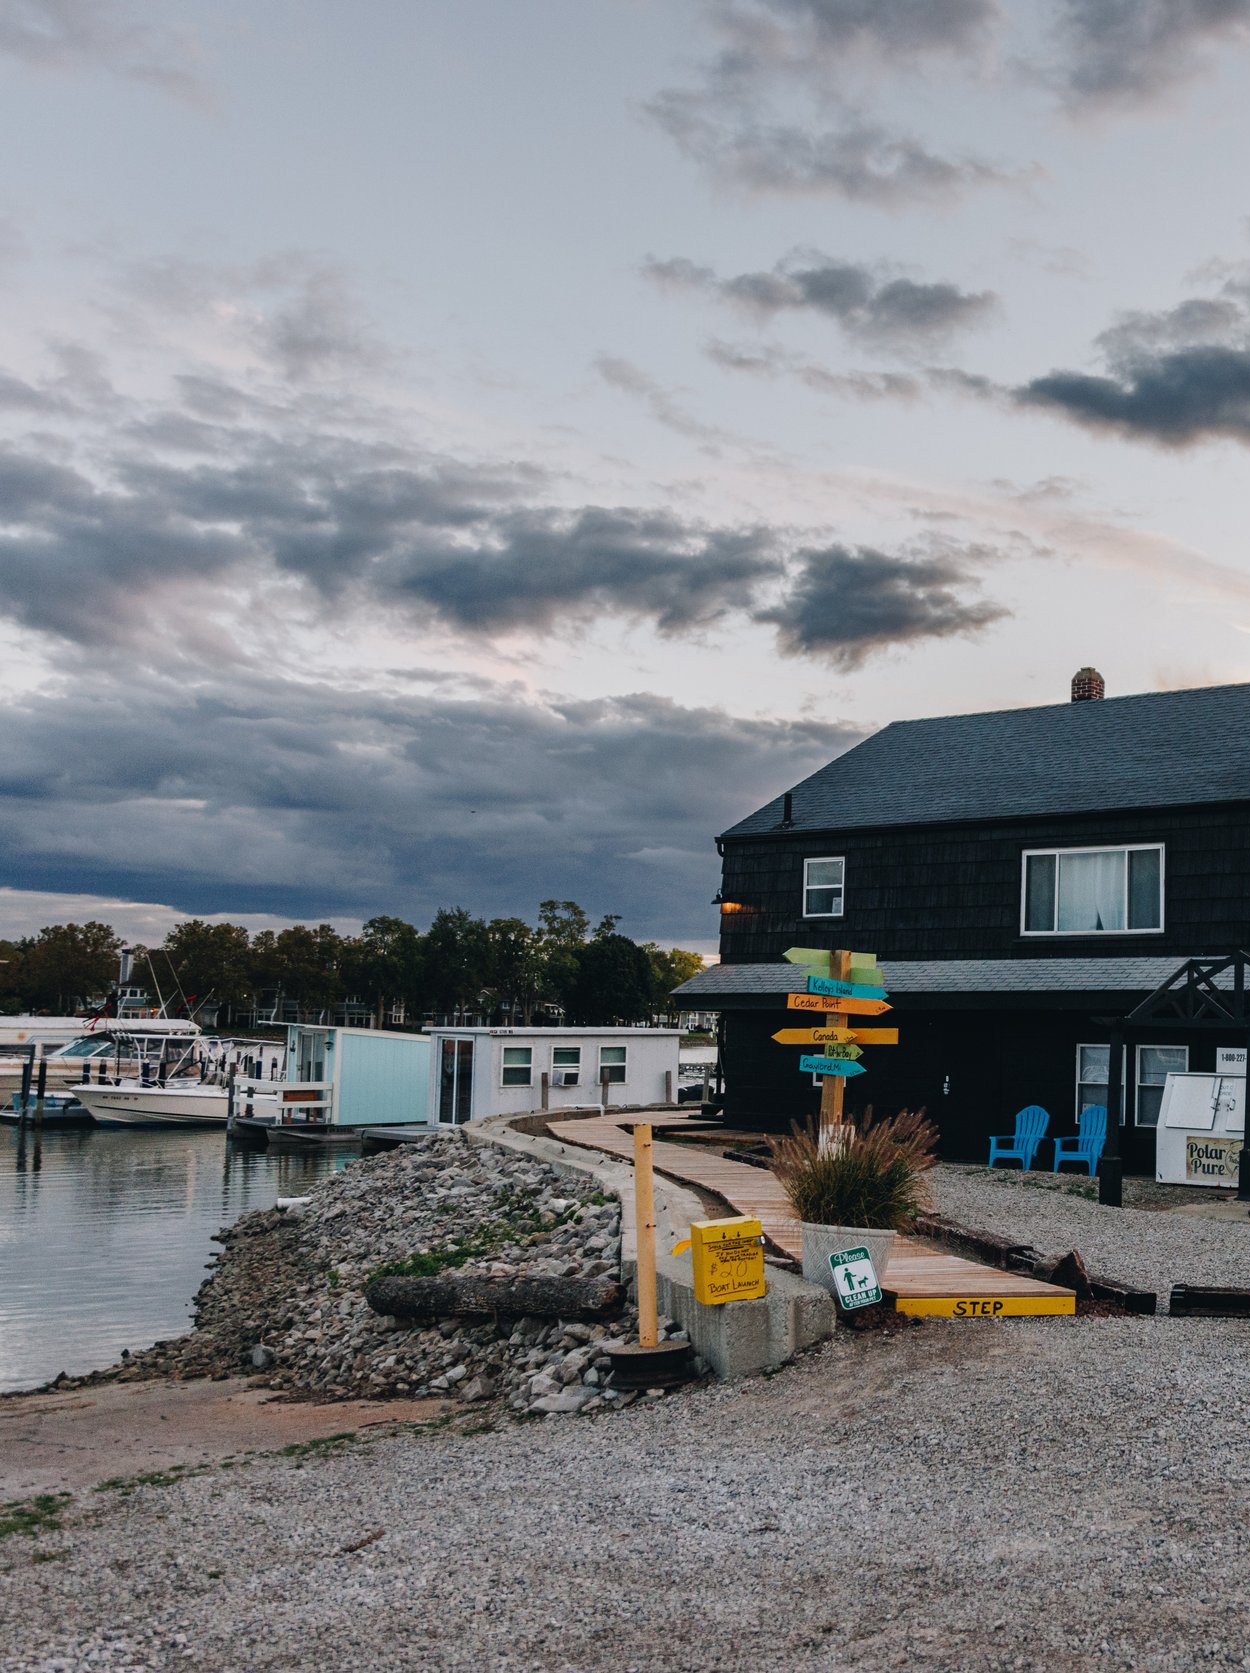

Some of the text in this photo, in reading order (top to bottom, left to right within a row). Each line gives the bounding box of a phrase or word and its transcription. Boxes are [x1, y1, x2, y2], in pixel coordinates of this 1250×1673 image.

[836, 985, 853, 996] Island
[794, 996, 842, 1009] Cedar Point
[812, 1030, 838, 1041] Canada
[1187, 1142, 1226, 1160] Polar
[1191, 1158, 1226, 1176] Pure
[834, 1253, 866, 1265] Please
[708, 1279, 760, 1294] BOAT LAUNCH
[845, 1289, 877, 1304] CLEAN UP
[953, 1301, 1004, 1316] STEP
